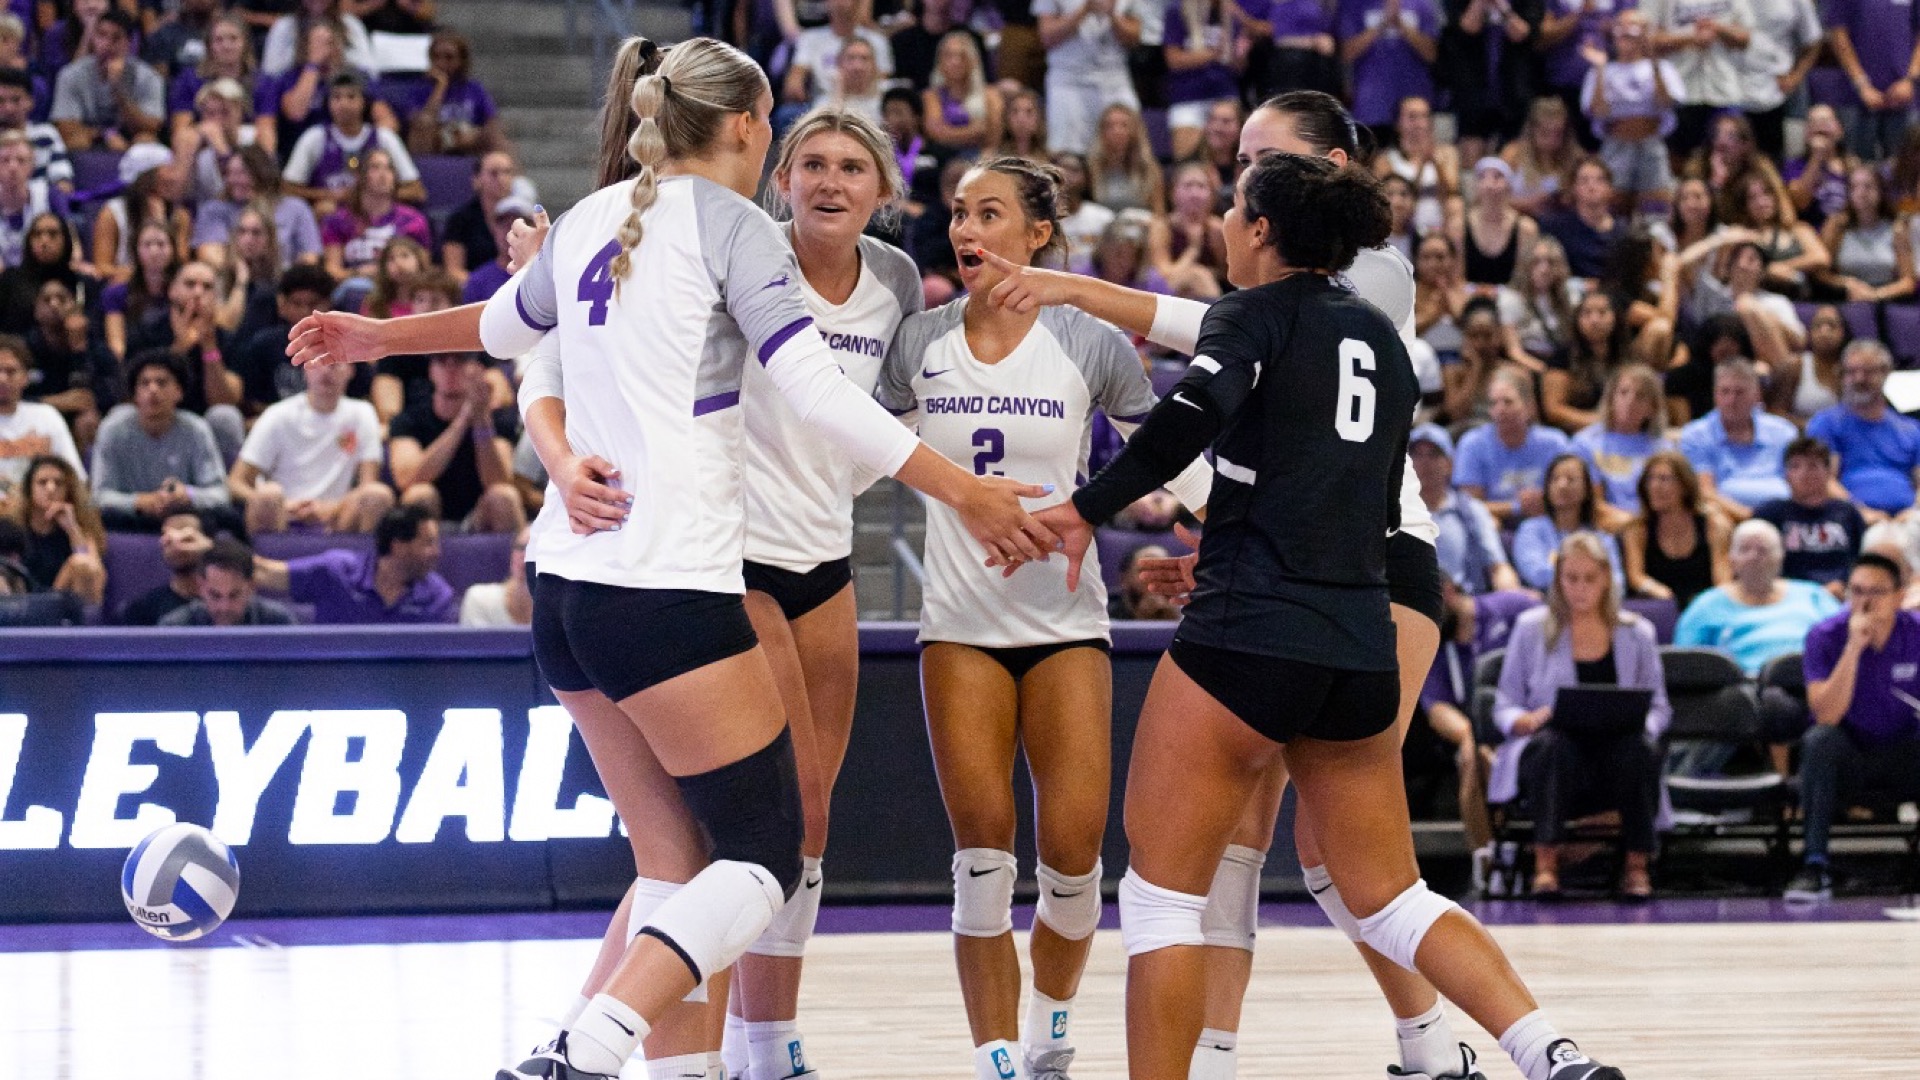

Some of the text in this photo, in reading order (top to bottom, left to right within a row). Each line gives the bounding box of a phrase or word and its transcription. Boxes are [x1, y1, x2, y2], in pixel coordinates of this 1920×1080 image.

[577, 238, 622, 326] 4
[829, 333, 885, 359] CANYON
[926, 396, 1065, 420] GRAND CANYON
[1334, 337, 1377, 443] 6
[971, 428, 1005, 476] 2
[0, 705, 629, 850] LEYBAL
